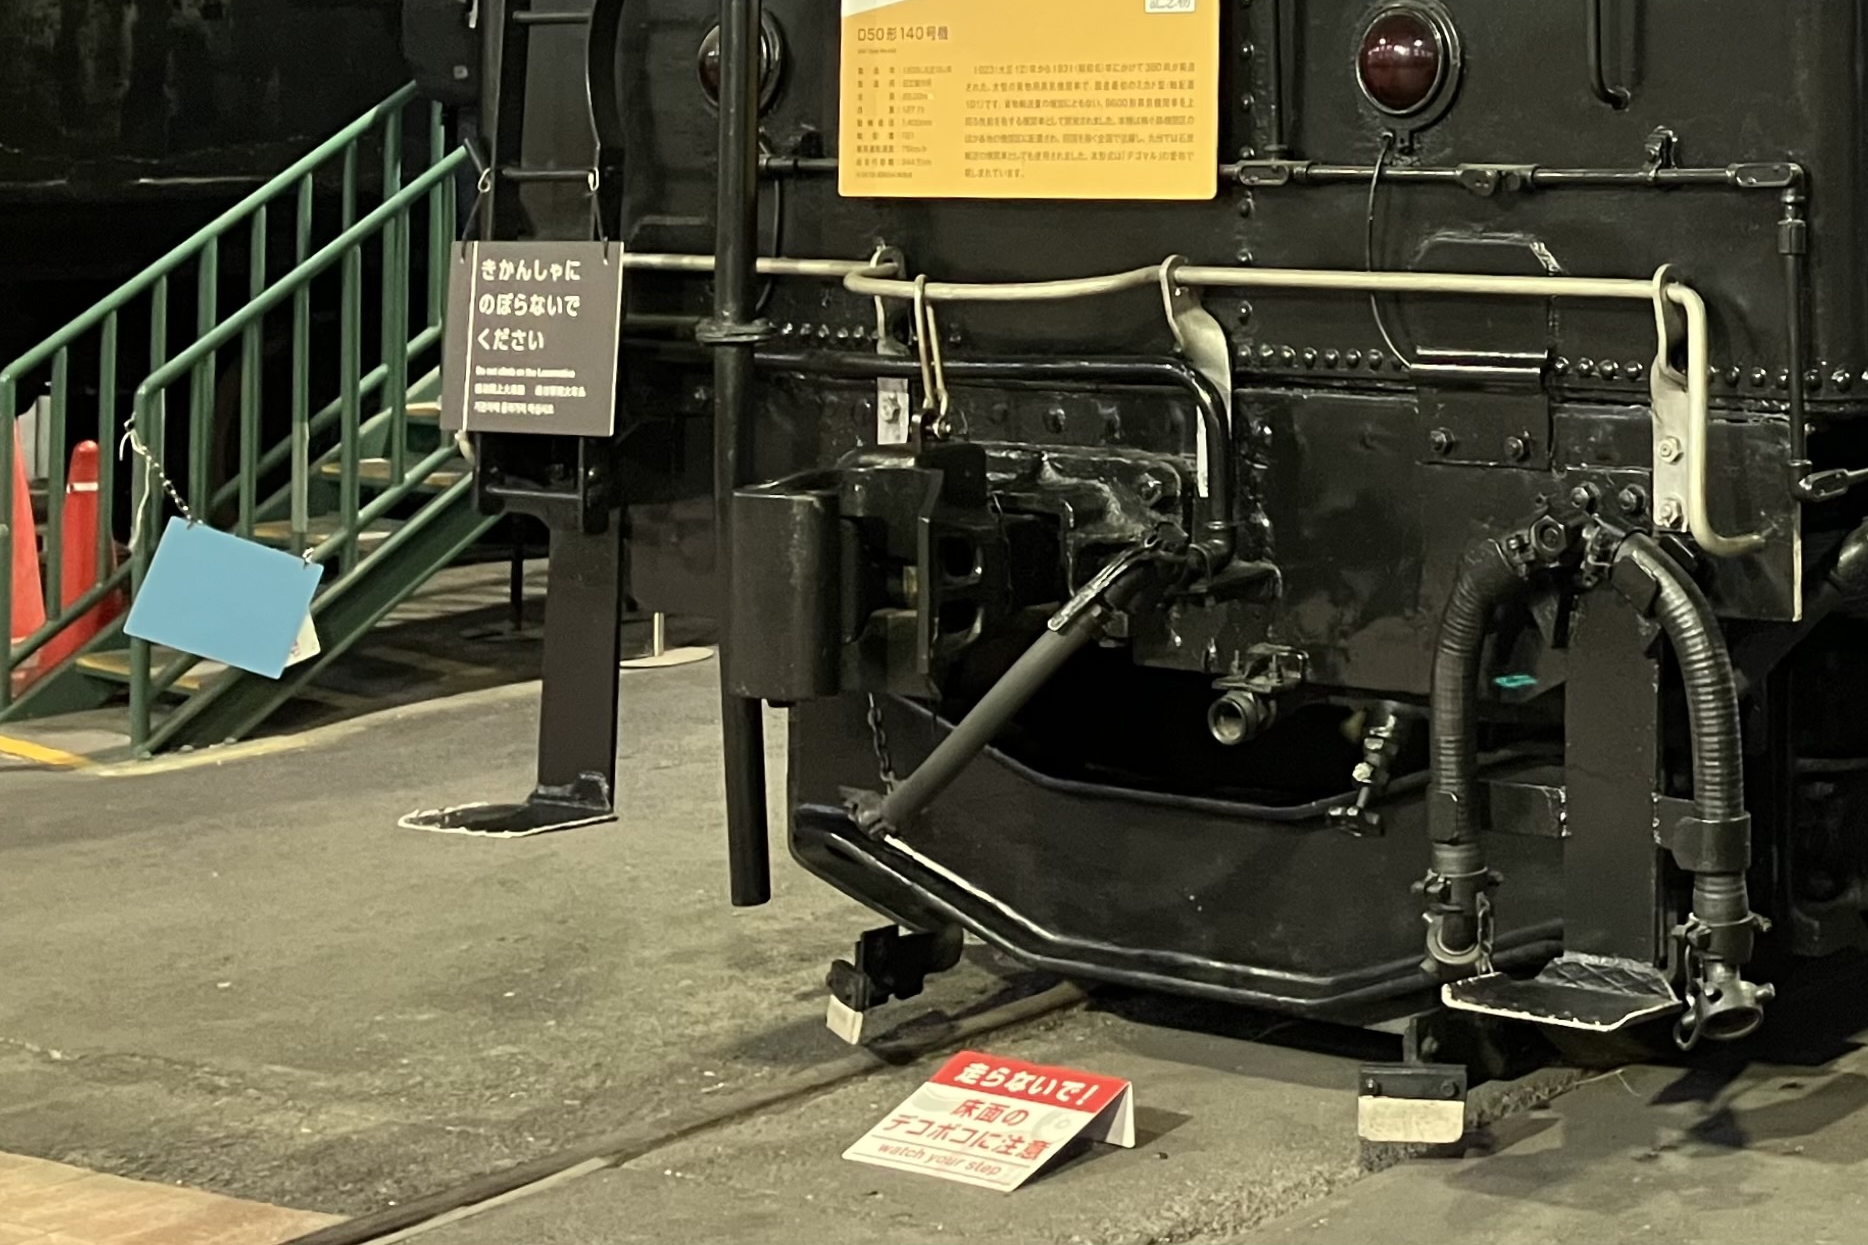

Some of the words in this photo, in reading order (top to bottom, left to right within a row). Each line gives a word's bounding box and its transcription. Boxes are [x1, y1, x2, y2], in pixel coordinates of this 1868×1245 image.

[481, 258, 581, 282] きかんしゃに
[479, 293, 580, 317] のぼらないで
[477, 327, 544, 351] ください
[953, 1061, 1100, 1106] 走らないで!
[950, 1098, 1030, 1127] 床面の
[883, 1114, 1052, 1161] デコボコに注意
[878, 1143, 926, 1160] watch
[927, 1150, 967, 1168] your
[965, 1158, 1003, 1177] step
